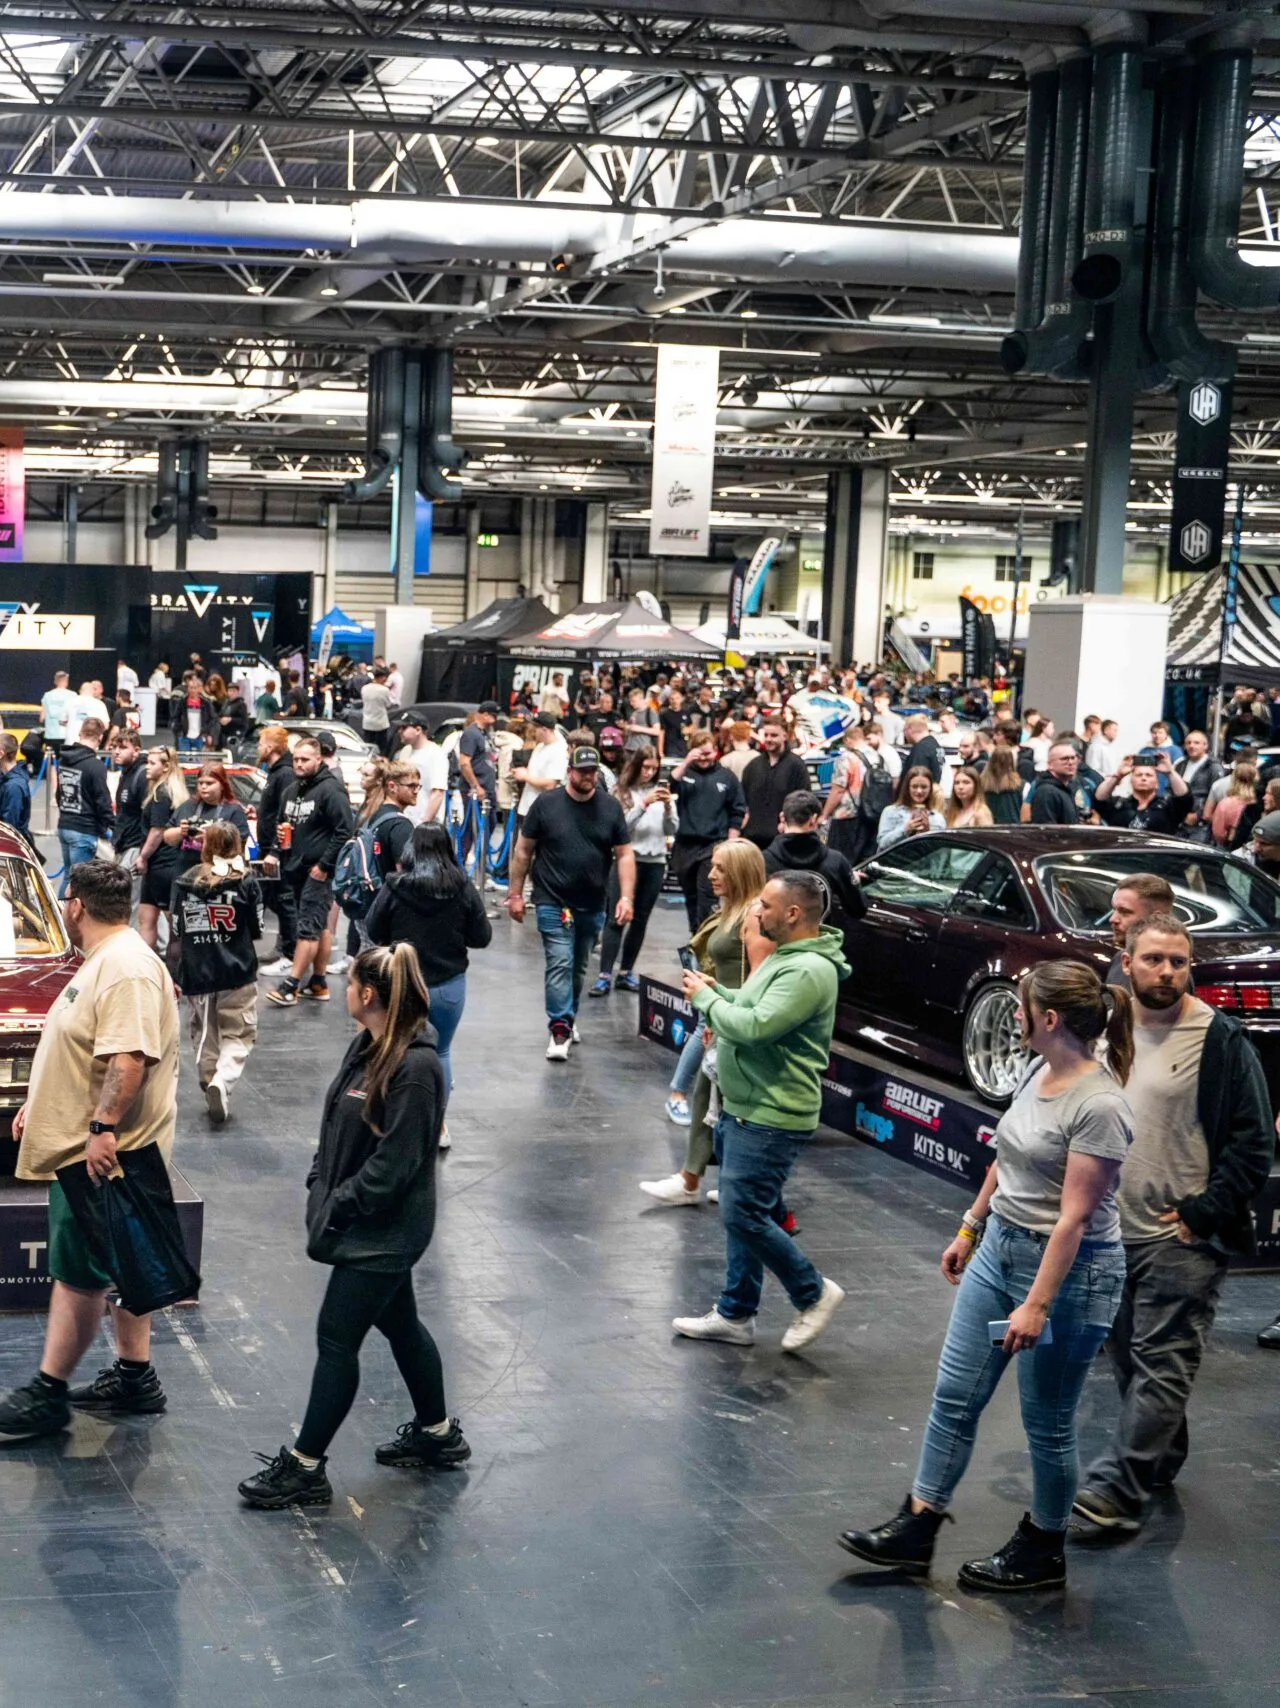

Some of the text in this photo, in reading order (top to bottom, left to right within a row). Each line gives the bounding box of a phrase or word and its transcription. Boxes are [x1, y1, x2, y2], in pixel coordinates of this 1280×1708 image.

[962, 584, 1028, 615] food
[207, 904, 237, 931] R
[913, 1133, 945, 1163] KITS
